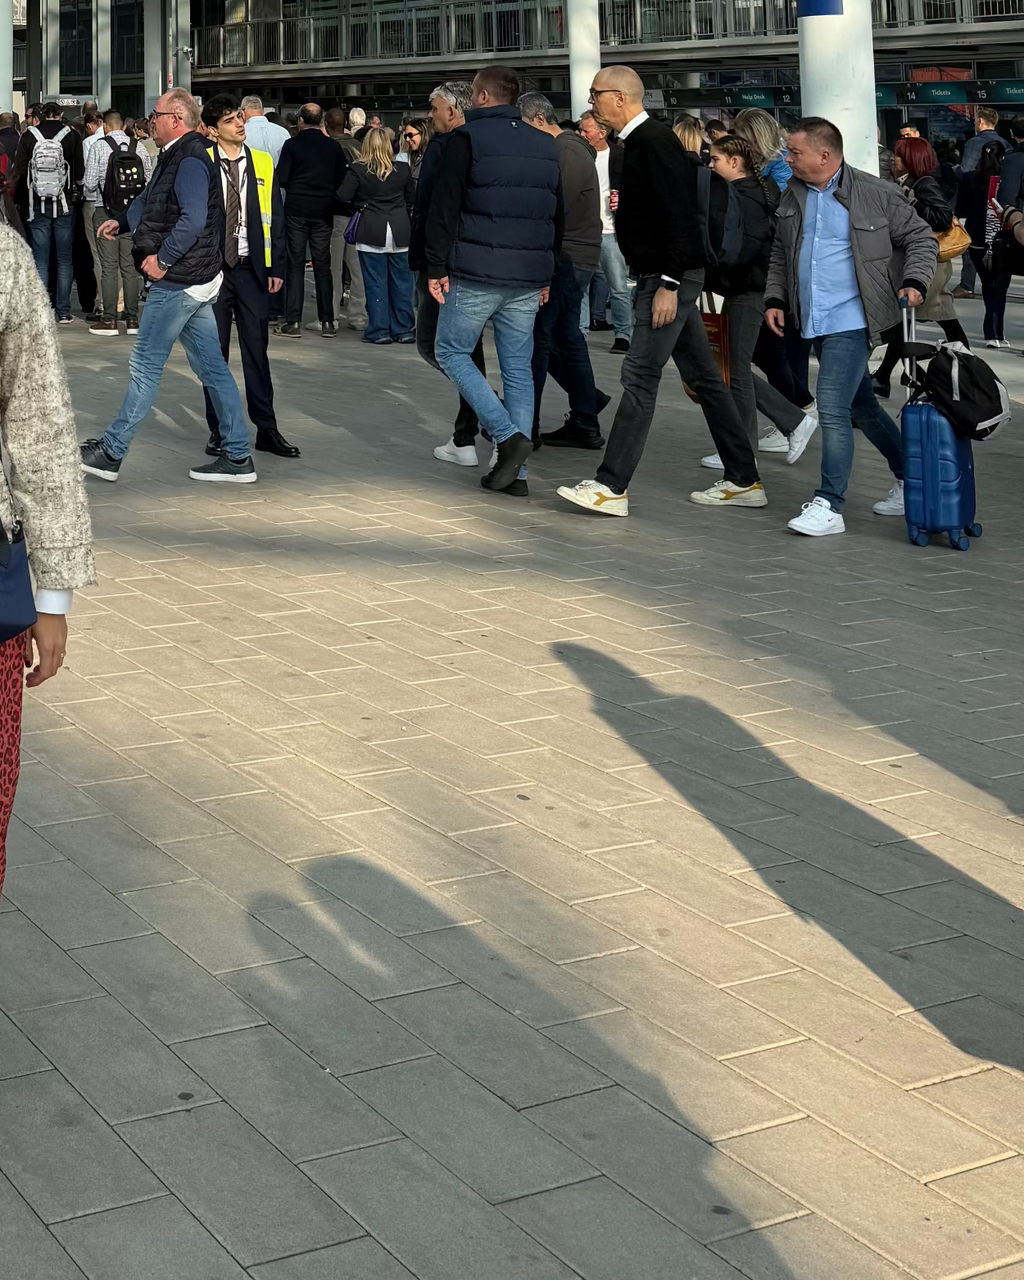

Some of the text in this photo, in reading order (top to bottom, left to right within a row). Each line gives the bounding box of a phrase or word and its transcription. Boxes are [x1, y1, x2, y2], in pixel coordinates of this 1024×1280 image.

[782, 94, 791, 103] 12
[907, 92, 916, 100] 14
[976, 90, 987, 99] 15
[670, 97, 677, 105] 10
[725, 96, 732, 104] 11
